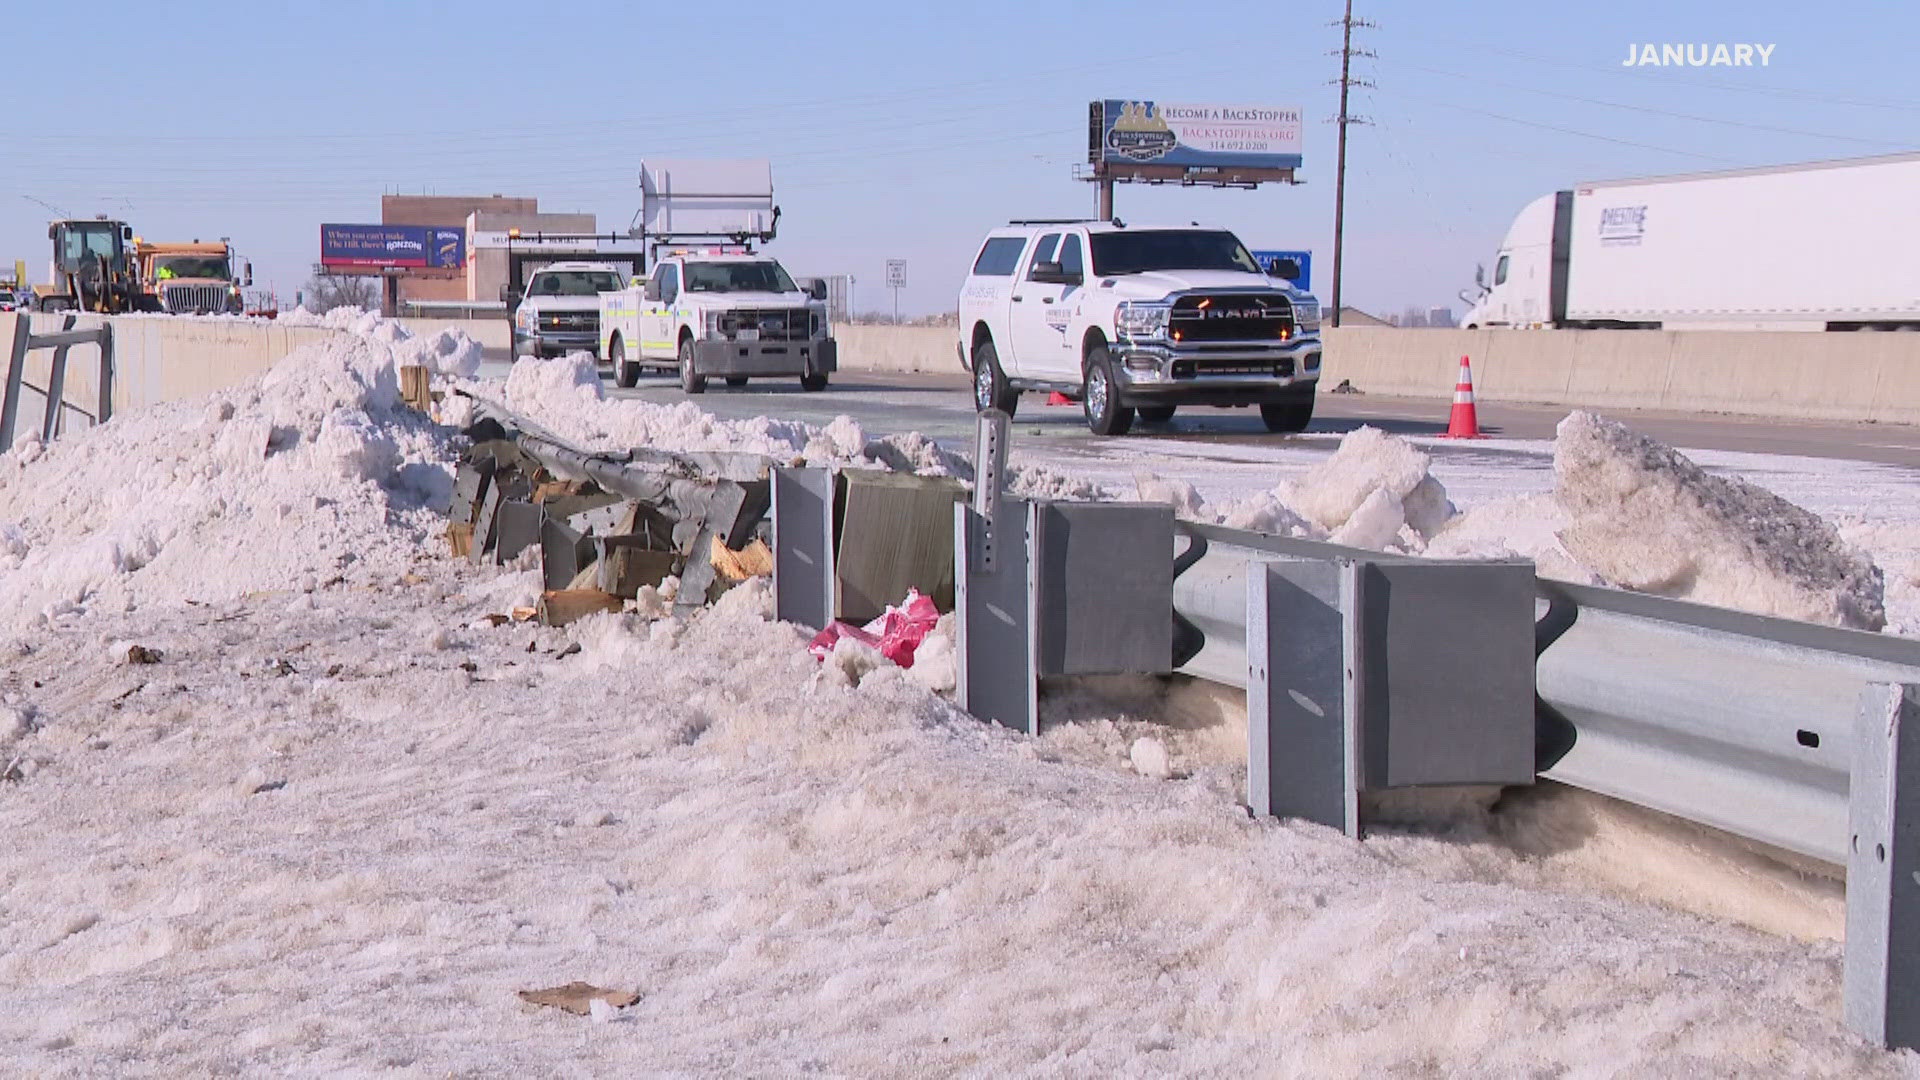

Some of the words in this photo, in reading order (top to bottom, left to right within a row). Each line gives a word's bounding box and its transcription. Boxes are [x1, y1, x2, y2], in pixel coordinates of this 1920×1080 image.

[1165, 108, 1209, 120] BECOME
[1212, 111, 1219, 120] A
[1209, 141, 1268, 151] 314.692.0200
[328, 231, 351, 239] When
[352, 232, 365, 242] you
[366, 231, 384, 240] can't
[385, 232, 405, 240] make
[329, 240, 342, 249] The
